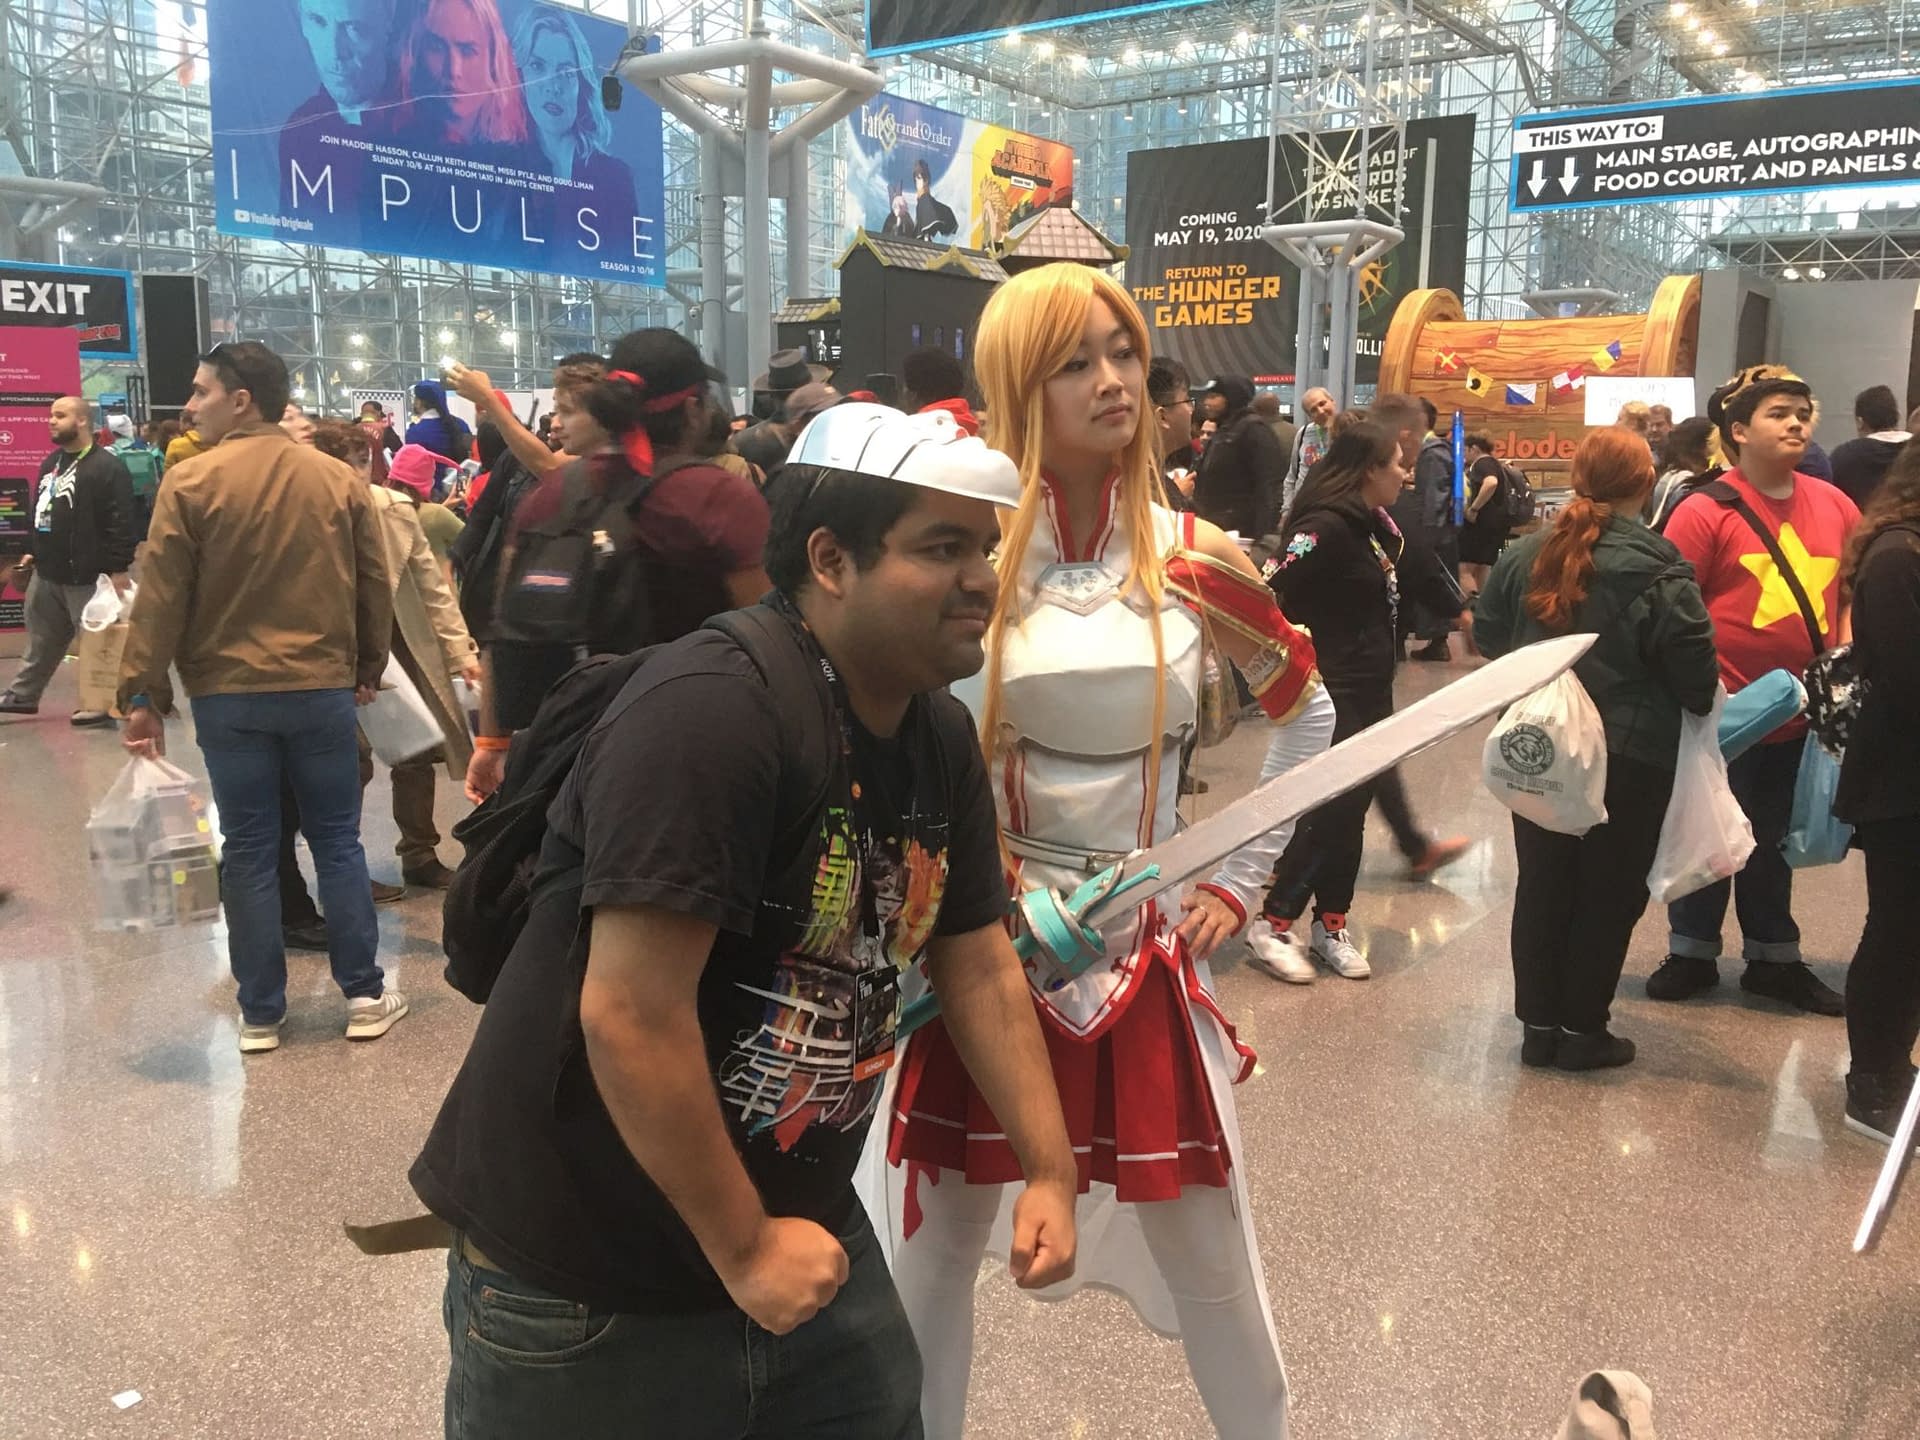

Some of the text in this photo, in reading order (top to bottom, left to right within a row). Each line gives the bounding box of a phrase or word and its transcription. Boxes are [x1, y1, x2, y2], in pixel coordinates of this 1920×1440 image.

[920, 122, 952, 147] Order
[1529, 122, 1656, 148] THIS WAY TO:
[320, 134, 594, 192] JOIN MADDIE HASSON, CALLUM KEITH RENNIE, MISSI PYLE, AND DOUG LIMAN
[1595, 147, 1654, 169] MAIN
[1660, 140, 1738, 163] STAGE,
[372, 154, 405, 168] SUNDAY
[424, 163, 434, 173] AT
[435, 165, 453, 176] 11AM
[454, 168, 478, 179] ROOM
[494, 175, 503, 184] IN
[503, 176, 527, 188] JAVITS
[528, 180, 555, 193] CENTER
[1302, 164, 1323, 177] TE
[1594, 171, 1660, 193] FOOD
[1663, 164, 1748, 187] COURT,
[1751, 159, 1806, 182] AND
[1811, 152, 1907, 177] PANELS
[230, 148, 656, 260] IMPULSE
[1332, 186, 1405, 210] SNKES
[1179, 211, 1238, 227] COMING
[1154, 225, 1263, 247] MAY 19, 2020
[600, 260, 630, 273] SEASON
[631, 264, 636, 274] 2
[1165, 264, 1248, 280] RETURN TO
[1, 279, 91, 316] EXIT
[1132, 275, 1281, 304] THE HUNGER
[1155, 301, 1254, 328] GAMES
[1259, 374, 1296, 383] SCHOLASTI
[1492, 430, 1577, 459] elode
